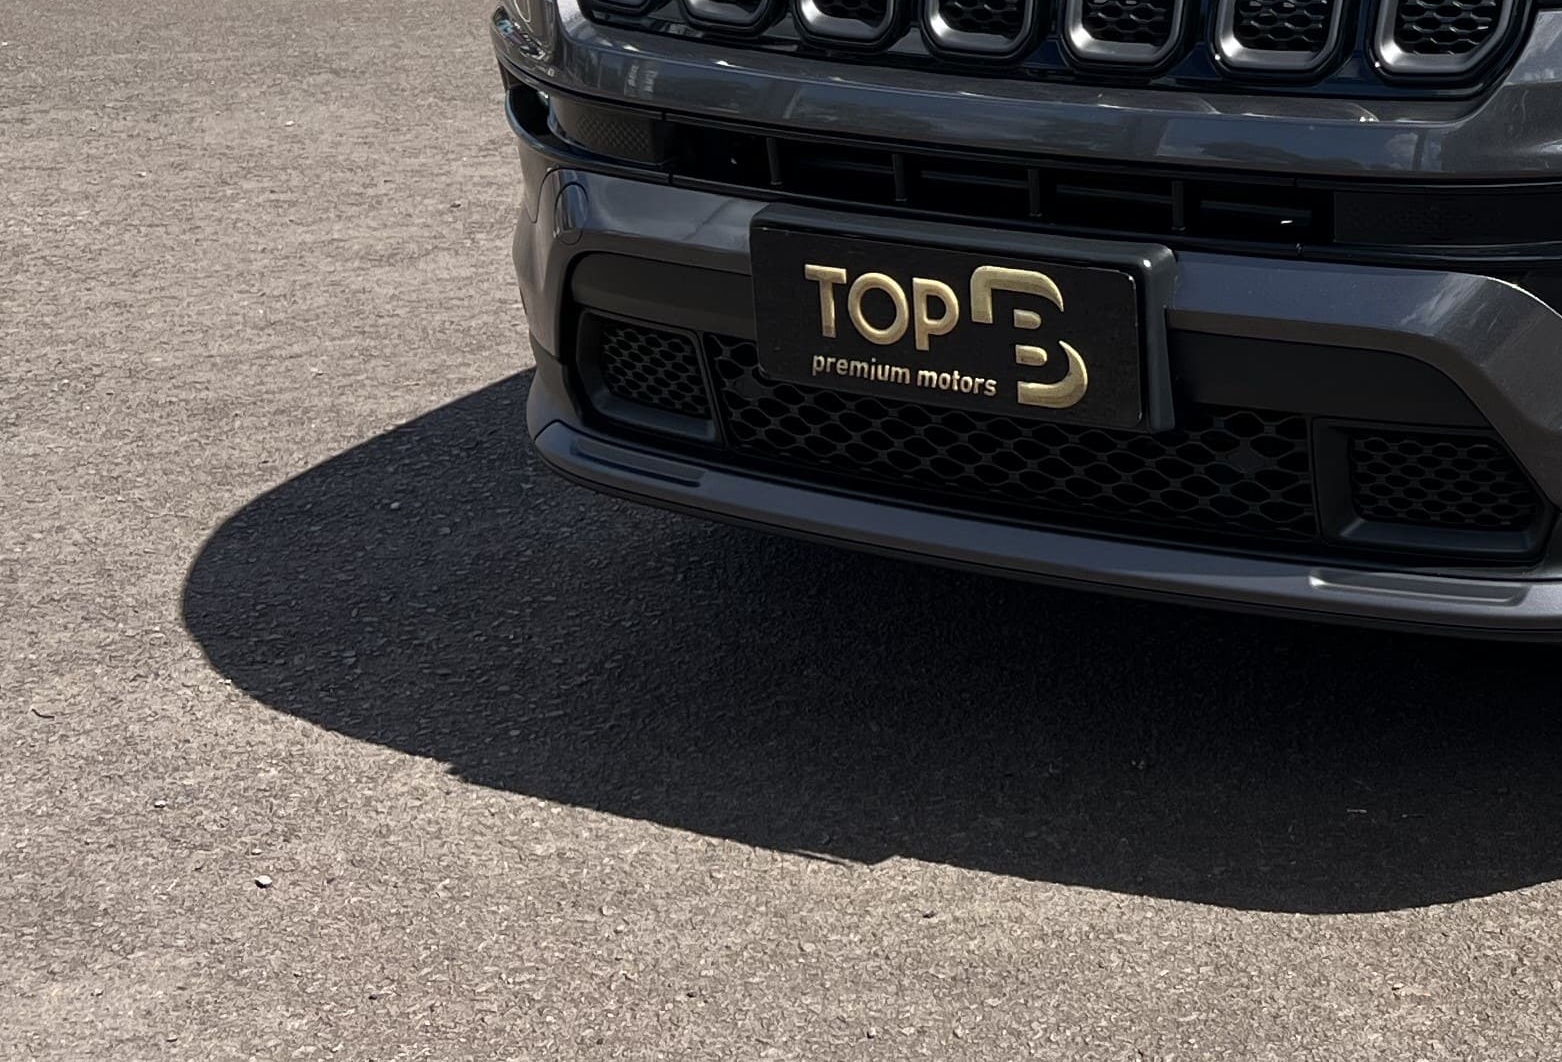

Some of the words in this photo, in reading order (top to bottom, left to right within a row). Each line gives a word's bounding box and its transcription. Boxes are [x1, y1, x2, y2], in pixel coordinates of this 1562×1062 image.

[804, 264, 960, 352] TOP
[812, 354, 911, 385] premium
[916, 368, 998, 397] motors
